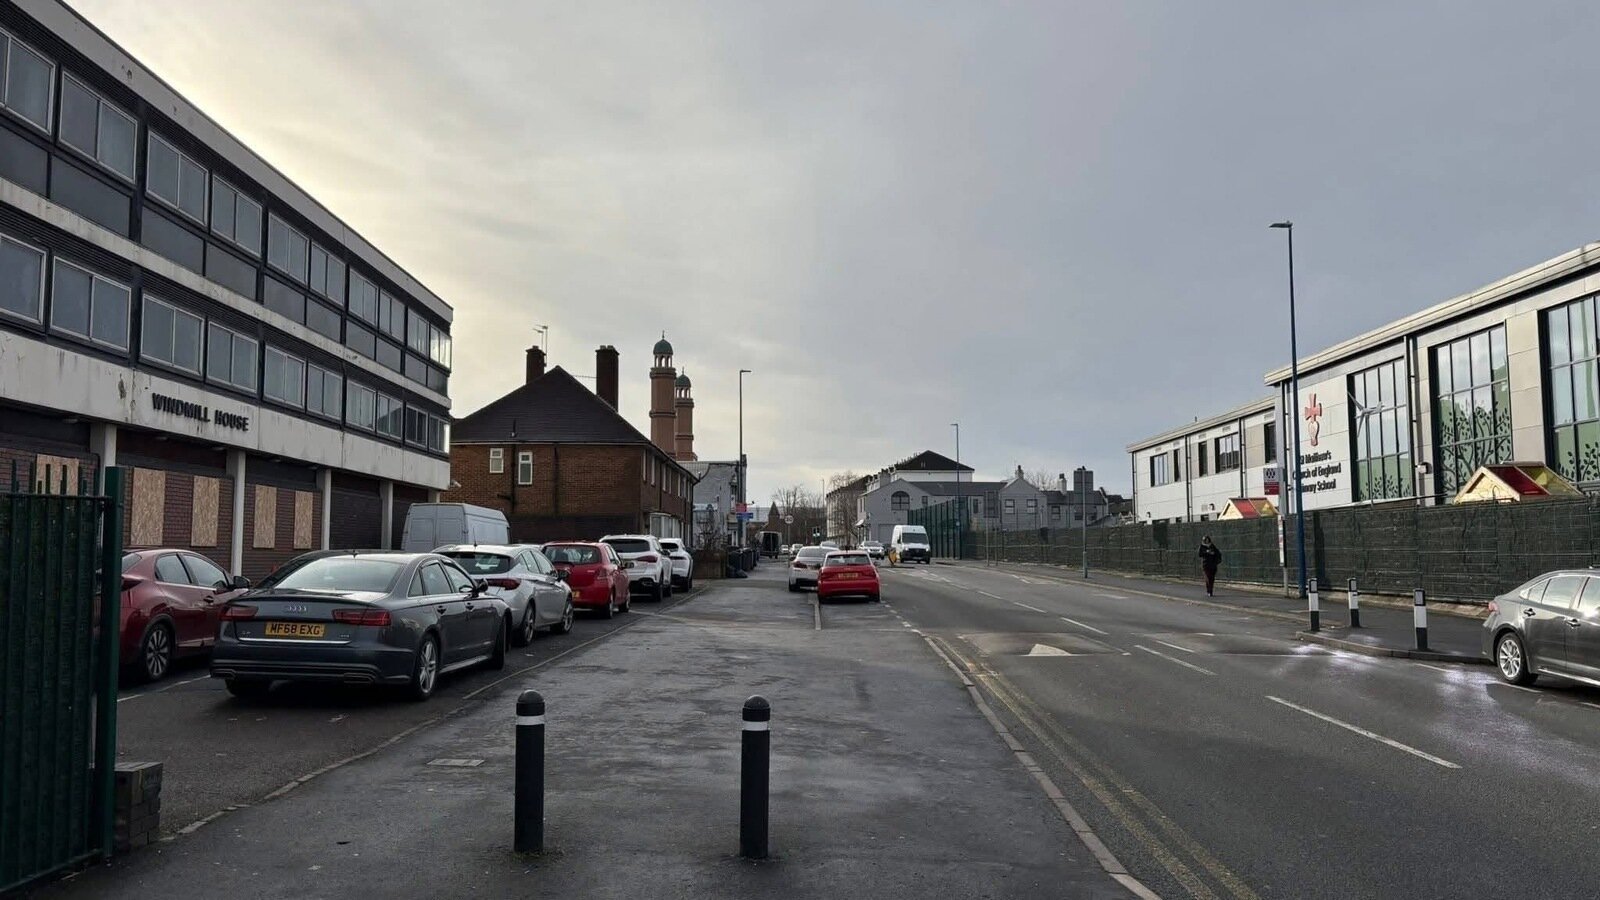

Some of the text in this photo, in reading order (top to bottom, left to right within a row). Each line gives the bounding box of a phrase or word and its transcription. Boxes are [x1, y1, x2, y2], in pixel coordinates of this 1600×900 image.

[152, 393, 249, 431] WINDMILL HOUSE
[1318, 462, 1341, 478] England
[1317, 479, 1336, 491] School
[270, 623, 321, 635] MF68 EXG
